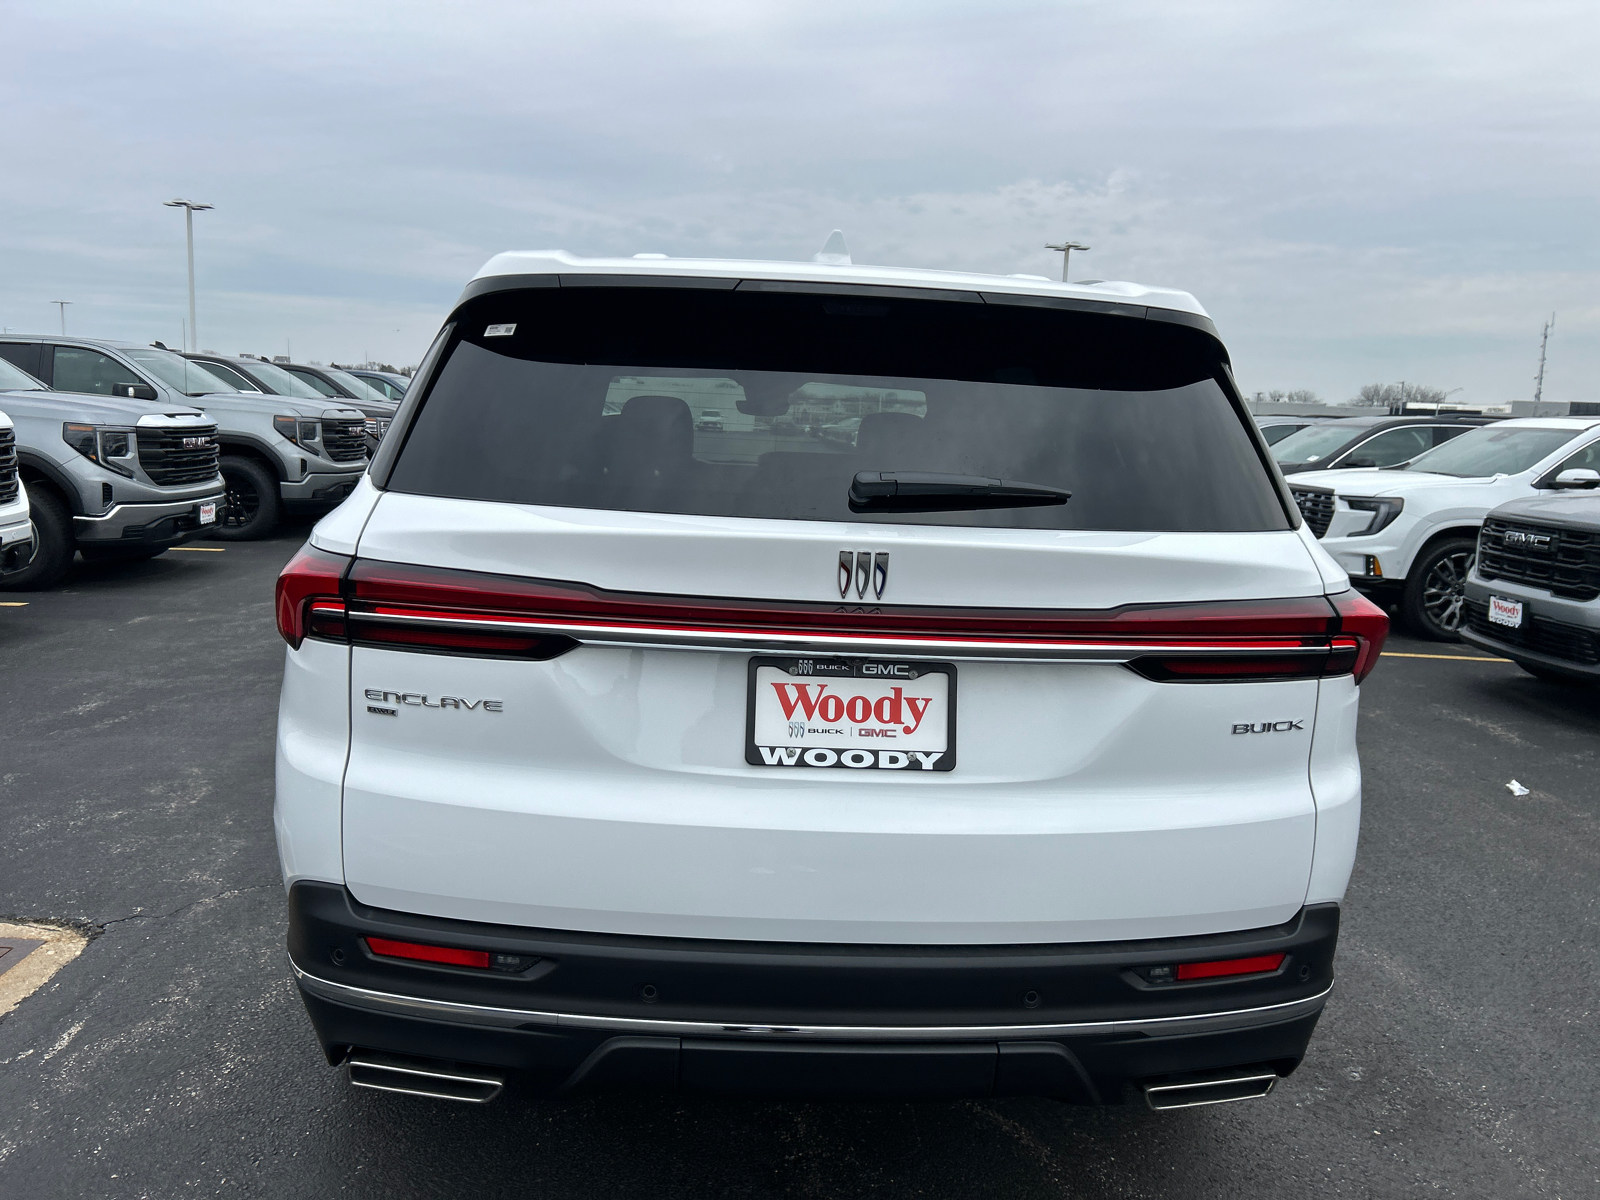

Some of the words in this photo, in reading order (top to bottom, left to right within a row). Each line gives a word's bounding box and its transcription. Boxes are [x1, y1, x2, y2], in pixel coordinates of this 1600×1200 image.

[1504, 531, 1550, 549] GMC
[1493, 600, 1520, 619] Woody
[862, 664, 909, 676] GMC
[364, 688, 504, 713] ENCLAVE
[770, 682, 933, 735] Woody
[858, 728, 897, 738] GMC
[1231, 719, 1304, 735] BUICK
[758, 746, 944, 770] WOODY
